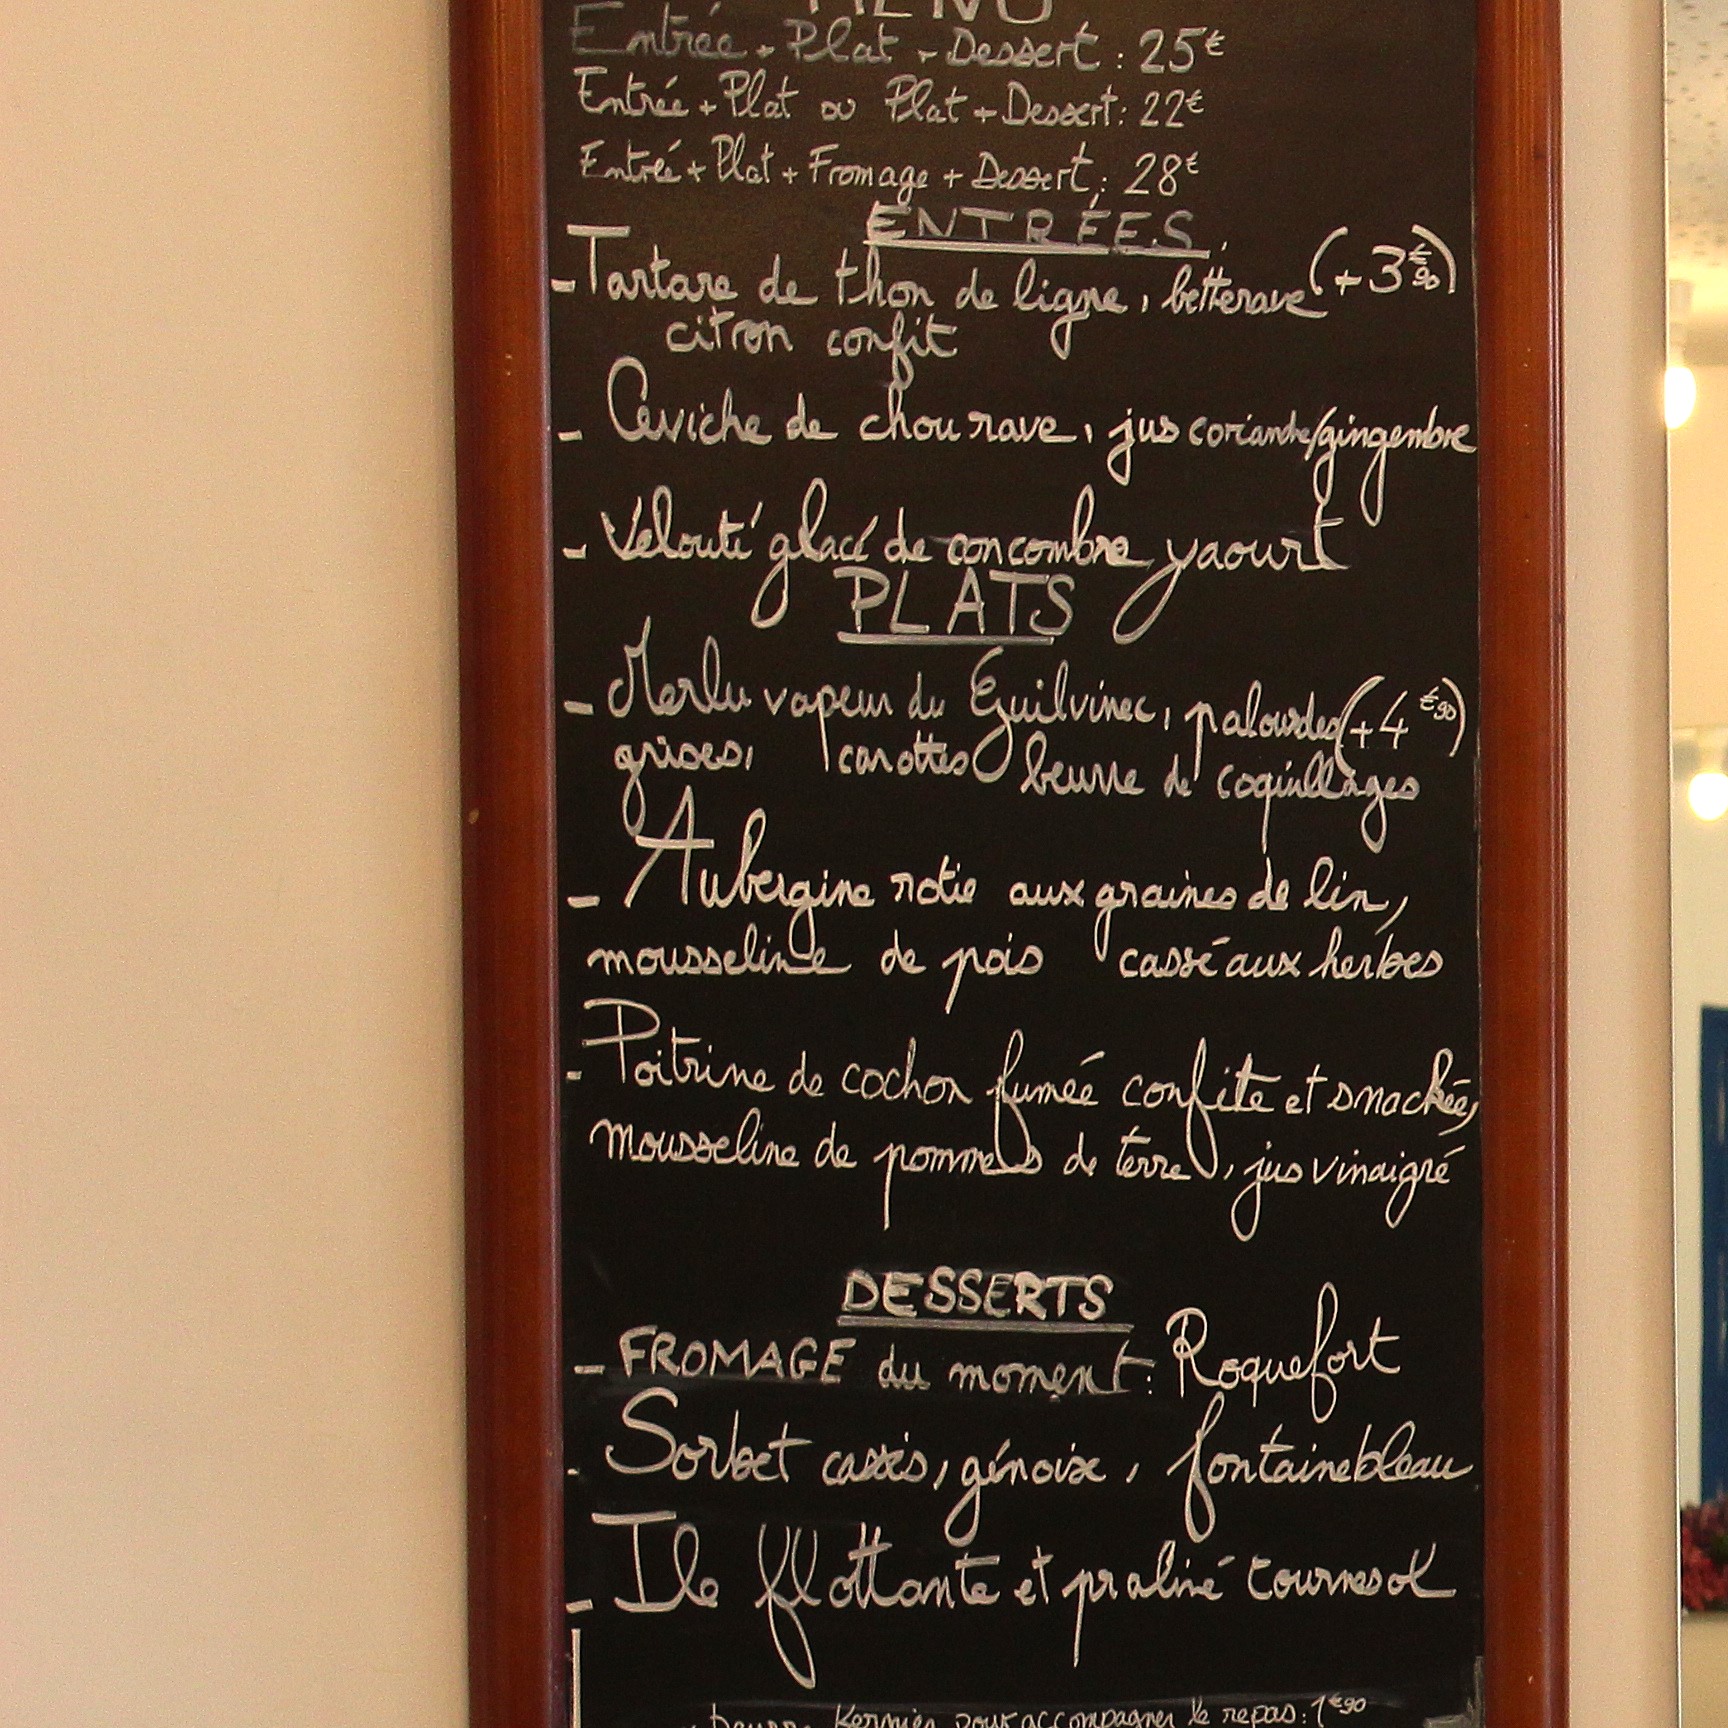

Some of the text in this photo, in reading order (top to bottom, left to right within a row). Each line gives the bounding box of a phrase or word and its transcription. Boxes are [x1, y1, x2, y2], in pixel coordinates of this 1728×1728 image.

[569, 2, 748, 60] Entrée
[782, 17, 900, 63] Plat
[1139, 28, 1226, 74] 25€
[573, 66, 691, 118] Entrée
[719, 69, 800, 120] Plat
[821, 98, 856, 121] ou
[885, 74, 969, 124] Plat
[1139, 89, 1205, 128] 22€
[711, 133, 775, 184] Plat
[808, 143, 930, 204] Fromage
[1123, 151, 1199, 197] 28€
[866, 194, 1194, 250] ENTRÉES
[567, 225, 738, 300] Tartare
[758, 254, 819, 305] de
[835, 243, 934, 306] thon
[956, 267, 998, 310] de
[1161, 263, 1328, 319] betterave
[667, 306, 959, 391] citron confit
[607, 355, 772, 446] Ceviche
[787, 392, 838, 443] de
[860, 381, 961, 445] chou
[1108, 408, 1180, 486] jus
[601, 485, 763, 562] Velouté
[751, 477, 879, 629] glacé
[884, 507, 932, 565] de
[946, 484, 1153, 567] concombre
[1113, 500, 1349, 645] yaourt
[833, 566, 1075, 637] PLATS
[607, 617, 752, 718] Merlu
[764, 684, 894, 772] vapeur
[908, 672, 944, 720] du
[1184, 680, 1341, 781] palourdes
[838, 731, 970, 776] carottes
[1021, 731, 1145, 796] beurre
[1164, 754, 1193, 799] de
[1217, 751, 1420, 854] coquillages
[624, 786, 875, 958] Aubergine
[1008, 876, 1085, 907] aux
[1094, 870, 1237, 962] graines
[1247, 856, 1289, 911] de
[587, 923, 1443, 1014] mousseline de pois cassé aux herbes
[582, 998, 776, 1093] Poitrine
[788, 1050, 824, 1097] de
[841, 1037, 973, 1105] cochon
[1122, 1037, 1281, 1180] confite
[1285, 1064, 1328, 1115] et
[815, 1121, 857, 1168] de
[874, 1144, 1043, 1231] pommes
[1063, 1132, 1098, 1176] de
[1230, 1141, 1303, 1241] jus
[1313, 1145, 1466, 1229] vinaigré
[618, 1324, 857, 1384] FROMAGE
[878, 1343, 931, 1391] du
[1166, 1281, 1401, 1423] Roquefort
[841, 1265, 1114, 1321] DESSERTS
[604, 1387, 813, 1482] Sorbet
[1167, 1391, 1474, 1544] fontainebleau
[591, 1510, 720, 1613] Ile
[755, 1521, 1001, 1689] flottante
[1014, 1545, 1053, 1606] et
[1062, 1540, 1236, 1668] praliné
[1247, 1542, 1457, 1601] tournesol
